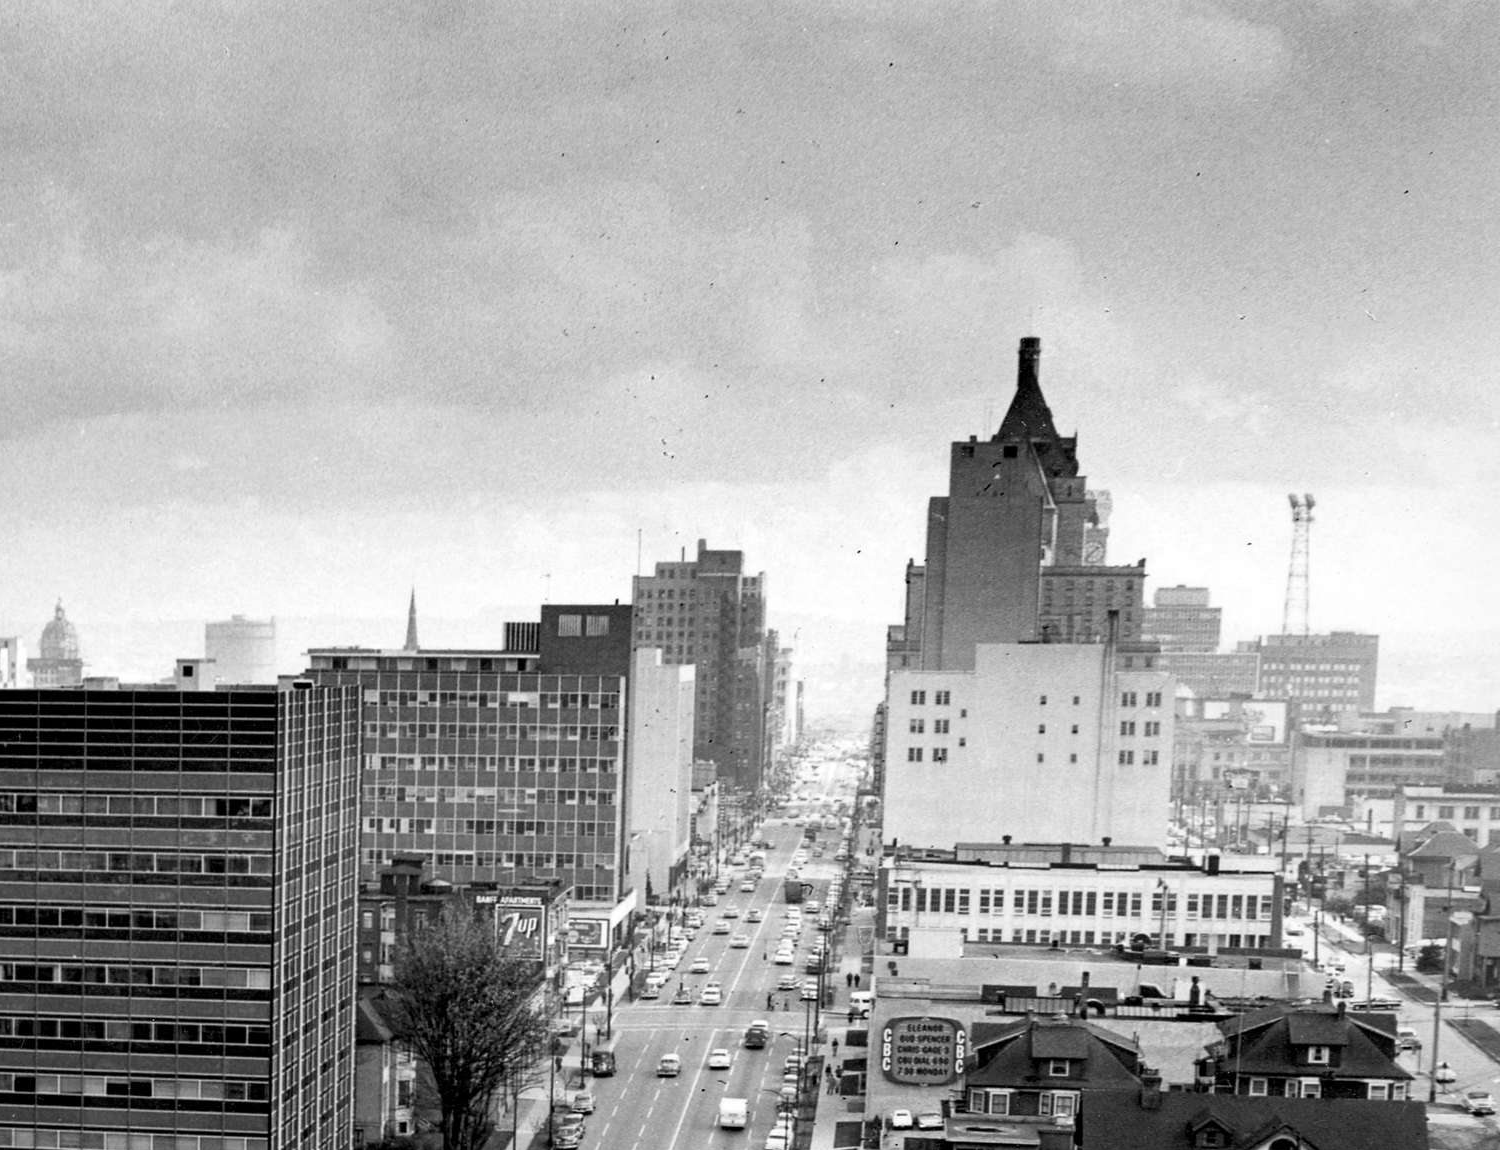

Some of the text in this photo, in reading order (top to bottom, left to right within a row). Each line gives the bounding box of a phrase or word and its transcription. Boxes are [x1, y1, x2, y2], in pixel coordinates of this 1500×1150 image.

[907, 1024, 944, 1032] ELEANOR
[882, 1028, 892, 1071] CBC
[955, 1030, 965, 1073] CBC
[914, 1056, 930, 1065] DIAL
[916, 1067, 948, 1076] MONDAY
